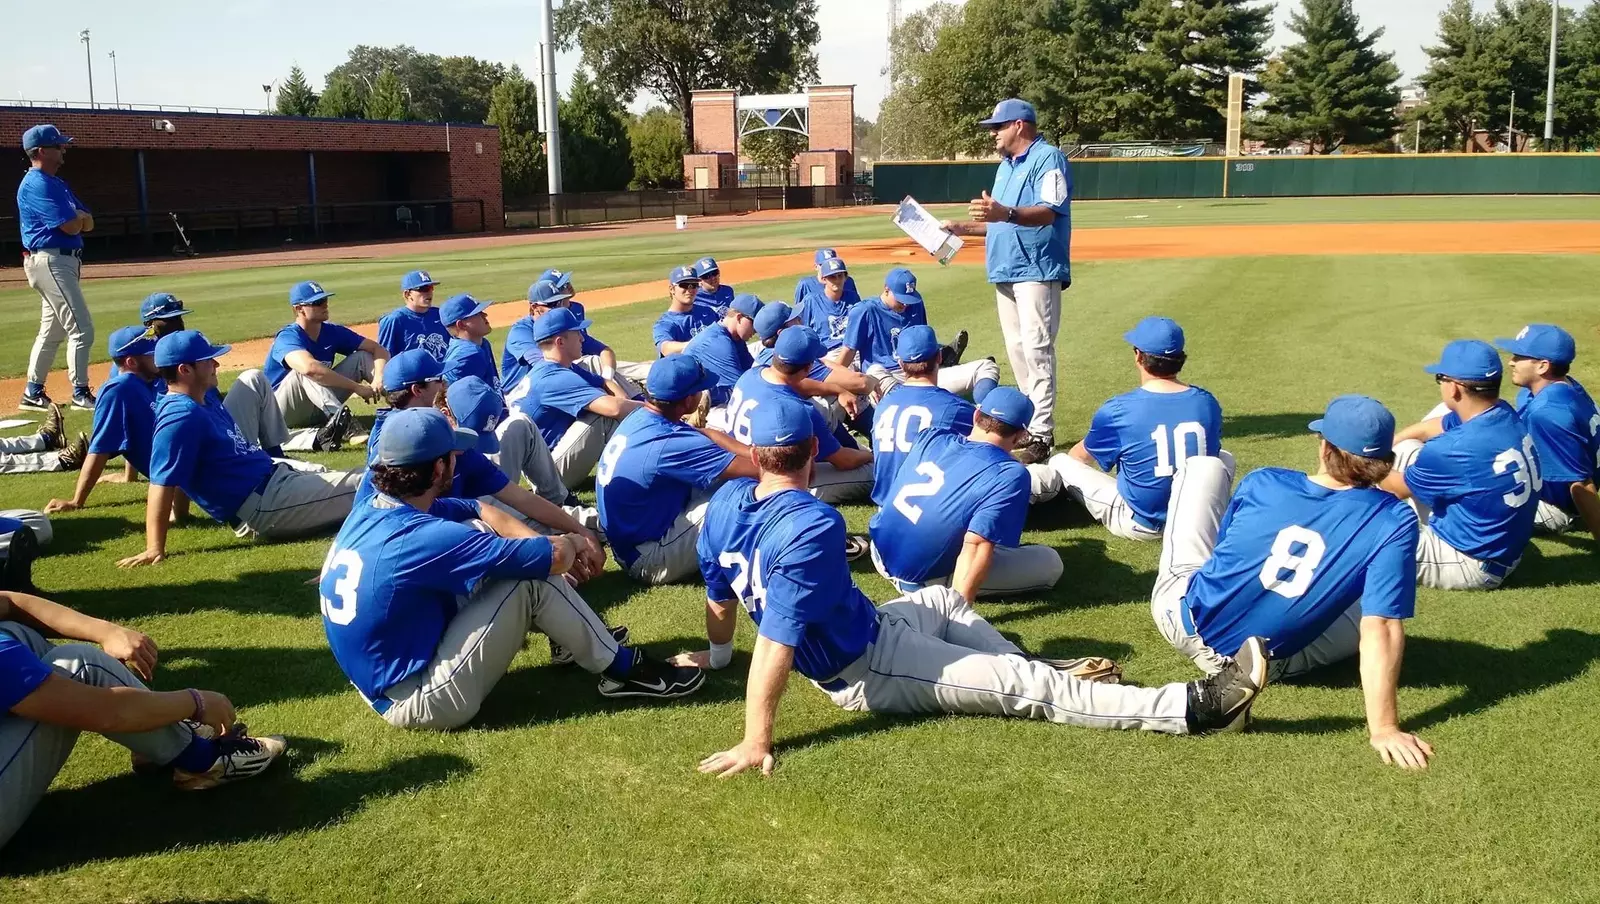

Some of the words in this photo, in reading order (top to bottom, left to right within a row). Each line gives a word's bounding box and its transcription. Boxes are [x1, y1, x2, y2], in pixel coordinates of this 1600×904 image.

[874, 405, 933, 453] 40
[1151, 421, 1207, 477] 10
[893, 461, 945, 525] 2
[718, 549, 767, 613] 24
[1258, 525, 1326, 598] 8
